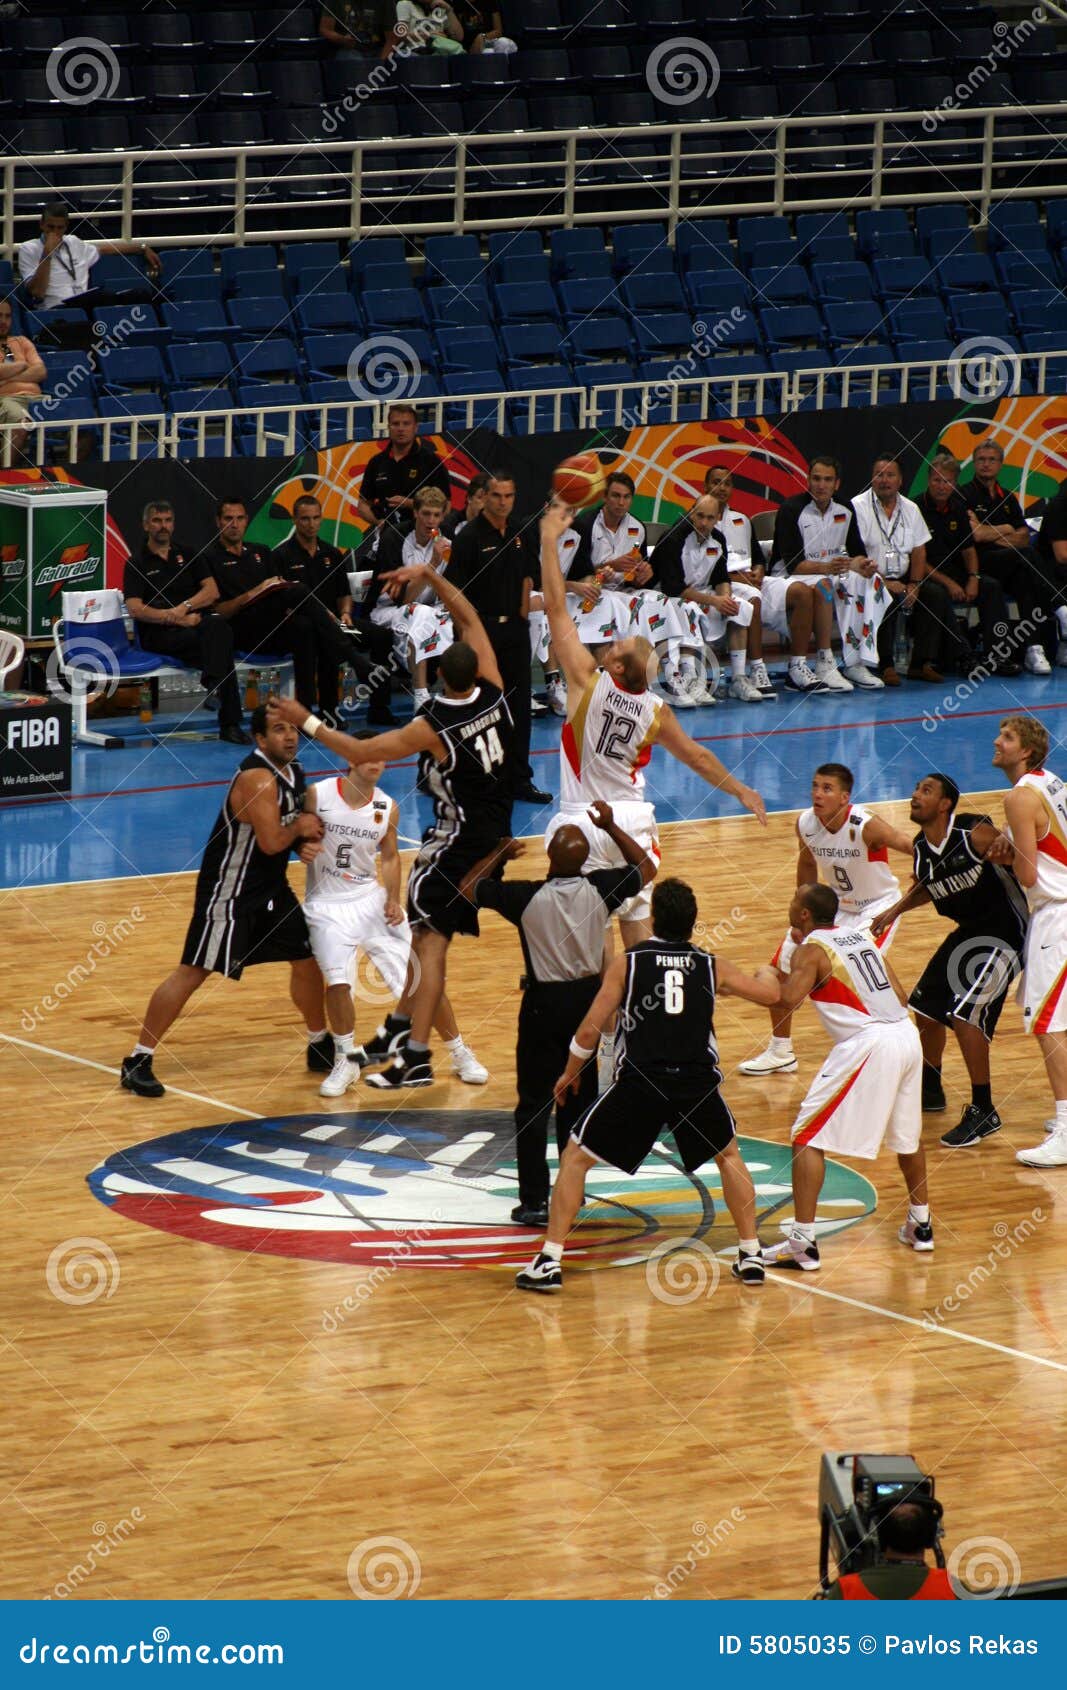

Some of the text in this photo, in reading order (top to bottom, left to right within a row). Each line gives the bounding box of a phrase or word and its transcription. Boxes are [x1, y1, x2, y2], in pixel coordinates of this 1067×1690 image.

[35, 556, 101, 587] Gatorade
[606, 691, 642, 717] KAMAN
[8, 716, 60, 750] FIBA
[596, 709, 636, 760] 12
[474, 726, 504, 773] 14
[3, 771, 64, 785] We Are Basketball
[323, 821, 379, 841] EUTSCHLAND
[335, 843, 353, 868] 5
[833, 865, 853, 892] 9
[656, 954, 691, 968] PENNEY
[847, 949, 891, 992] 10
[664, 969, 684, 1014] 6
